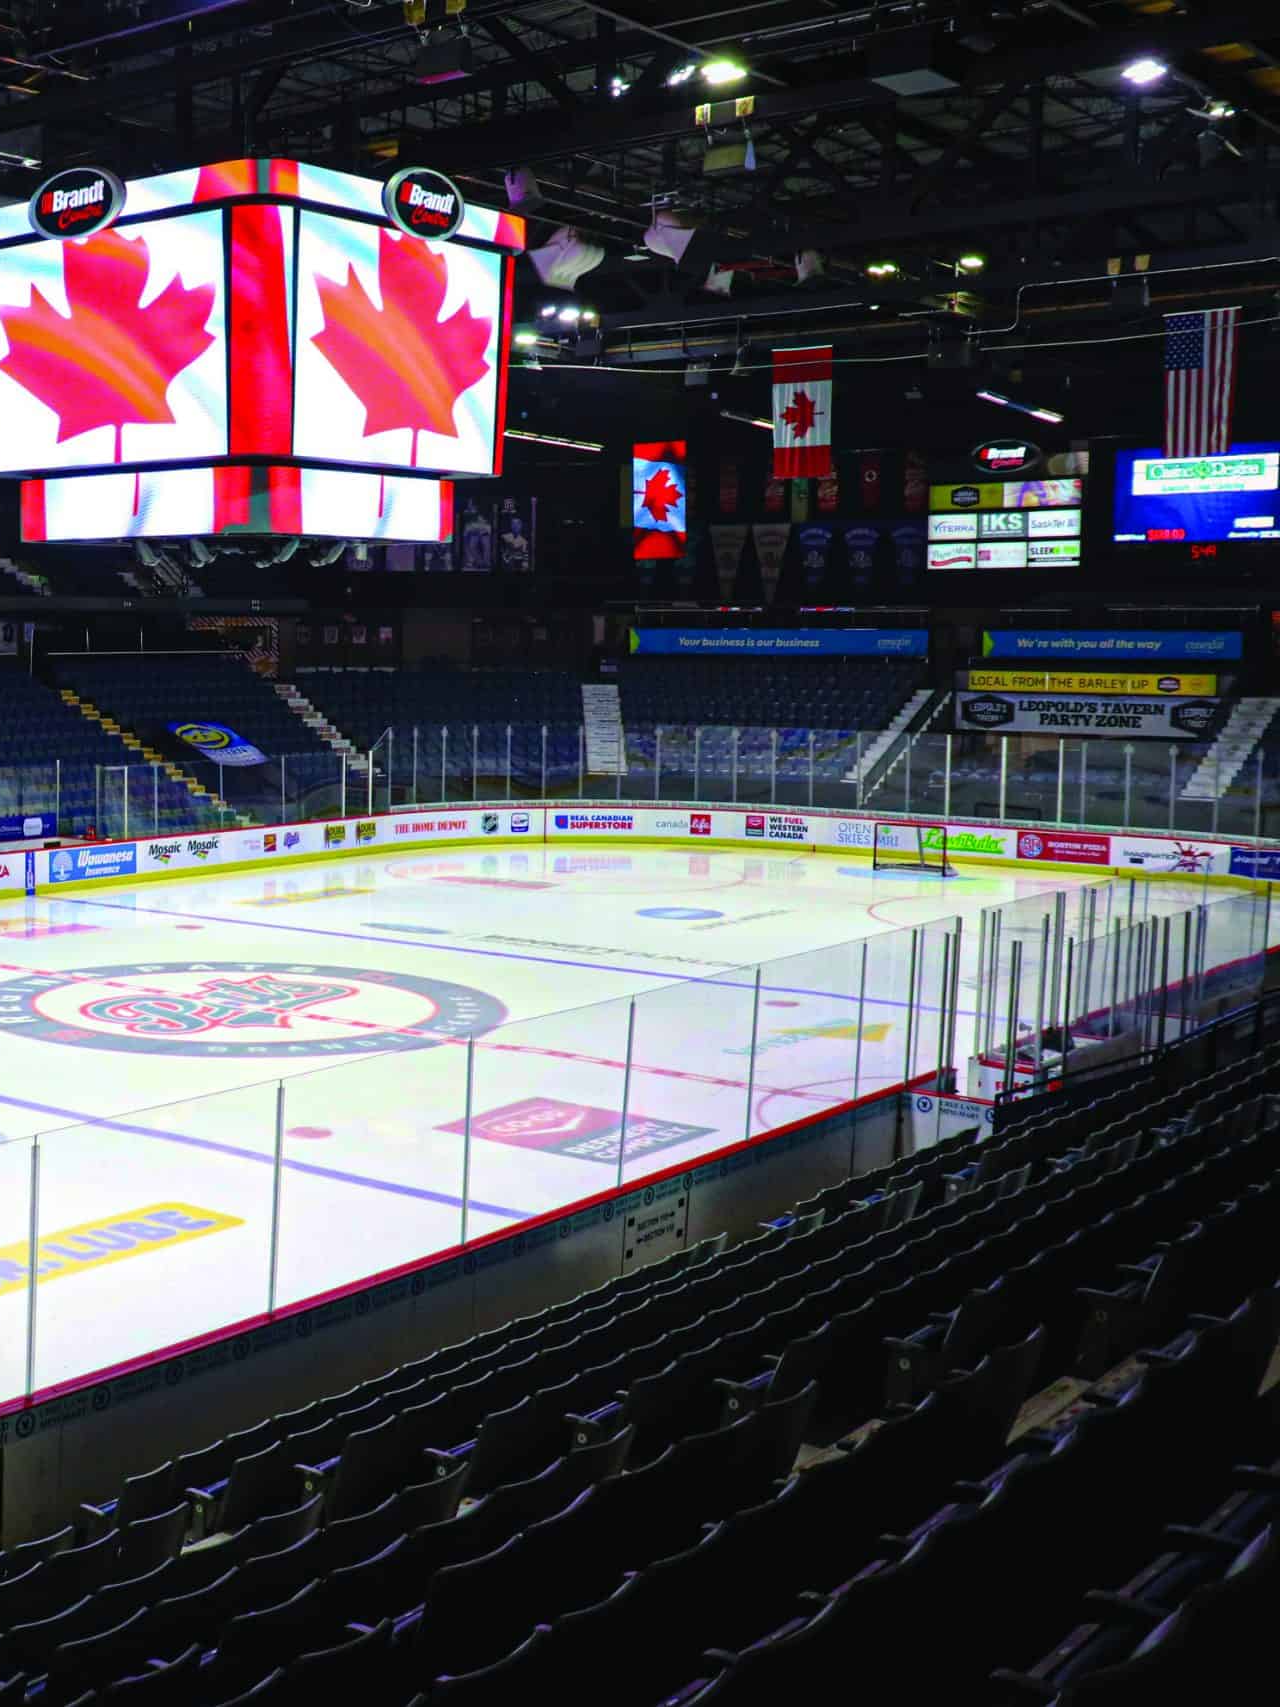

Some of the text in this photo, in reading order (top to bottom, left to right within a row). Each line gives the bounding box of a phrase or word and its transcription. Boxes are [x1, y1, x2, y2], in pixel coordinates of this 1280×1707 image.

[53, 180, 104, 213] Brandt
[408, 183, 455, 215] Brandt
[679, 637, 820, 648] Your business is our business
[1017, 638, 1163, 651] We're with you all the way
[970, 675, 1149, 690] LOCAL FROM THE BARLEY UP
[1017, 700, 1097, 714] LEOPOLD'S
[1101, 702, 1166, 716] TAVERN
[1039, 714, 1143, 730] PARTY ZONE
[437, 820, 467, 832] DEPOT
[570, 821, 633, 830] SUPERSTORE
[656, 819, 688, 829] canada
[784, 816, 804, 825] FUEL
[769, 824, 808, 832] WESTERN
[838, 822, 871, 834] OPEN
[769, 831, 804, 840] CANADA
[837, 833, 871, 845] SKIES
[149, 841, 181, 857] Mosaic
[187, 837, 219, 852] Mosaic
[78, 848, 134, 867] Wawanesa
[137, 963, 317, 975] PATS
[207, 1036, 405, 1054] BRANDT
[43, 1209, 217, 1261] LUBE
